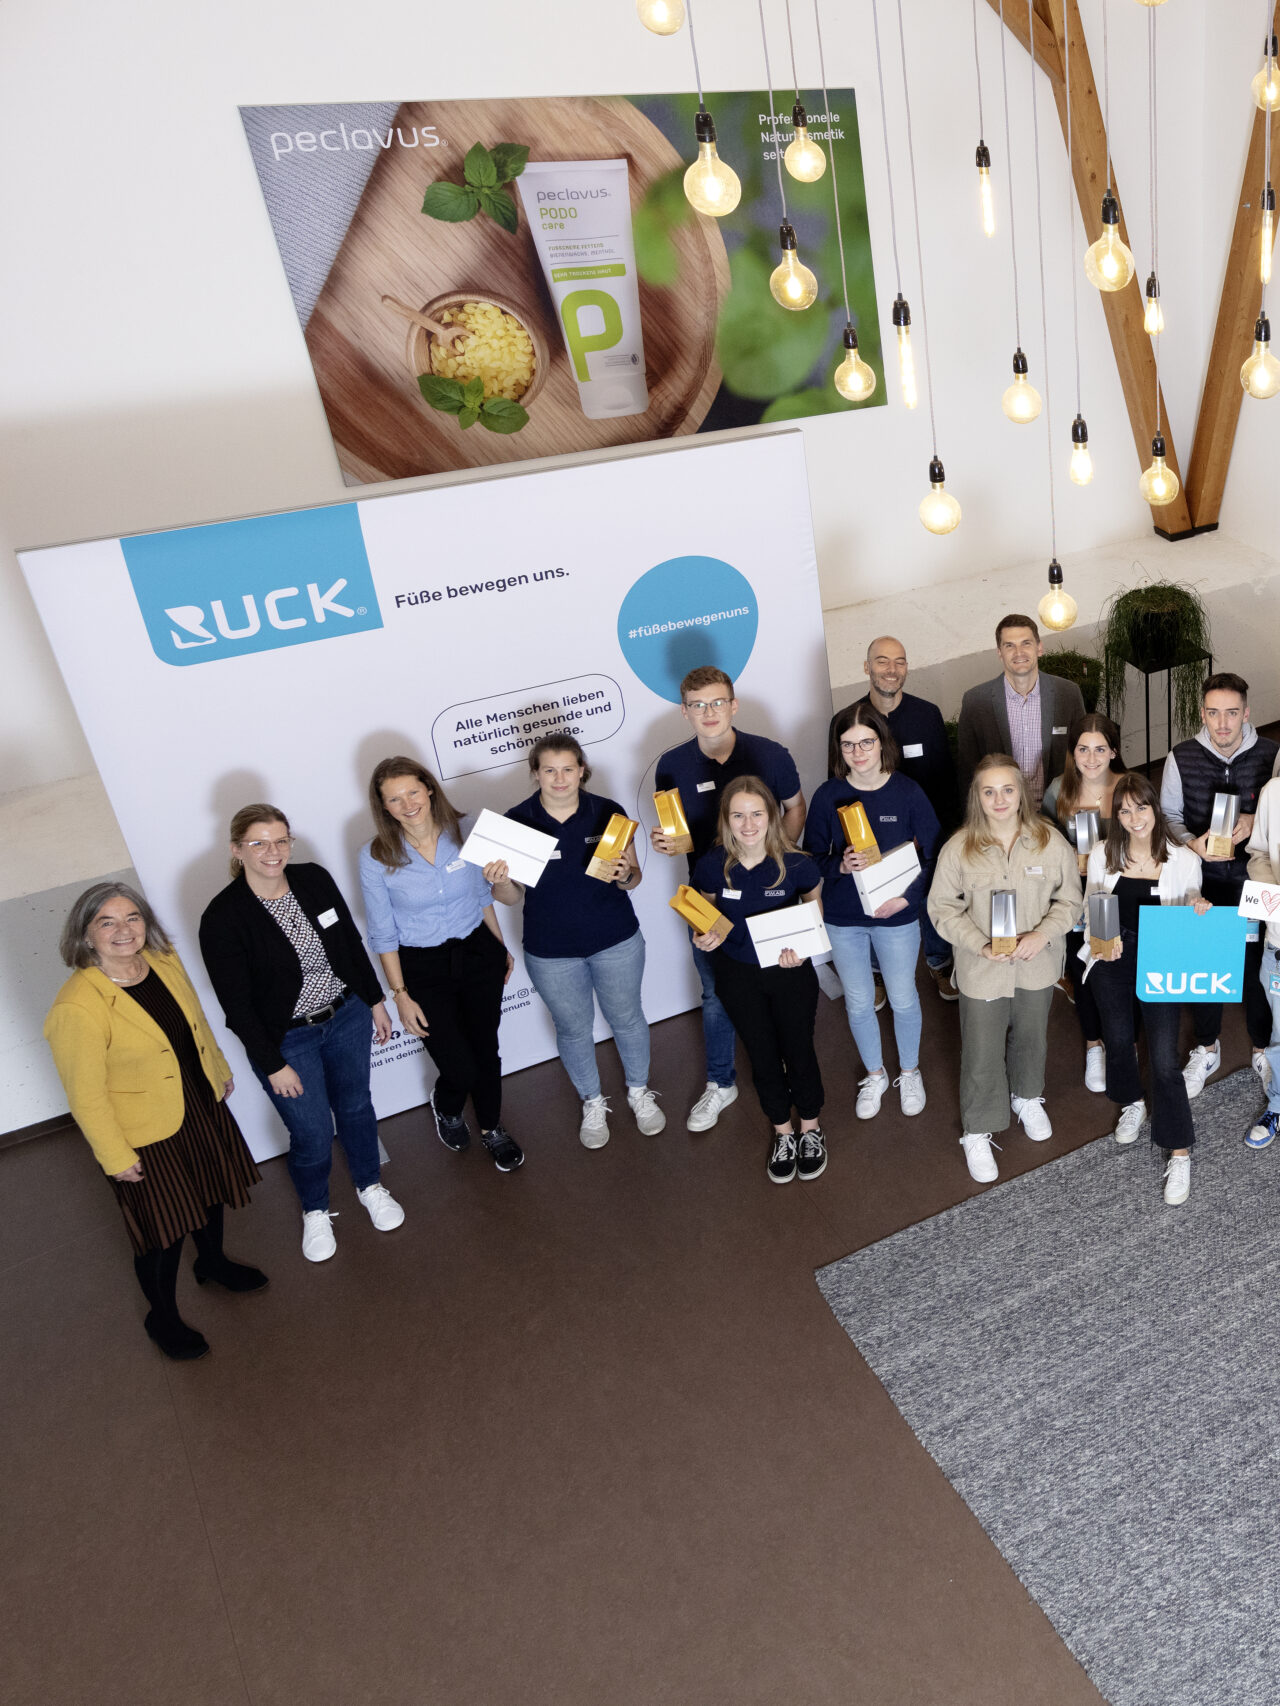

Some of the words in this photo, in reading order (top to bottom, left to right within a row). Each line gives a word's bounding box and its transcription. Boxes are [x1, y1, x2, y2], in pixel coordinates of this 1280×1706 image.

[758, 112, 840, 126] Profeonele
[760, 128, 845, 143] Natursmetik
[763, 149, 784, 161] set
[539, 206, 578, 220] PODO
[542, 222, 565, 231] care
[395, 590, 443, 609] Füße
[446, 574, 529, 599] bewegen
[532, 567, 570, 582] uns.
[164, 578, 355, 650] RUCK
[628, 606, 750, 639] #füßebewegenuns
[455, 718, 483, 732] Alle
[486, 701, 560, 725] Menschen
[562, 690, 605, 707] lieben
[453, 724, 520, 748] natürlich
[522, 710, 583, 734] gesunde
[585, 701, 612, 716] und
[490, 735, 542, 755] schöne
[1245, 895, 1259, 904] We
[1145, 972, 1232, 994] RUCK
[370, 1043, 402, 1057] nseren
